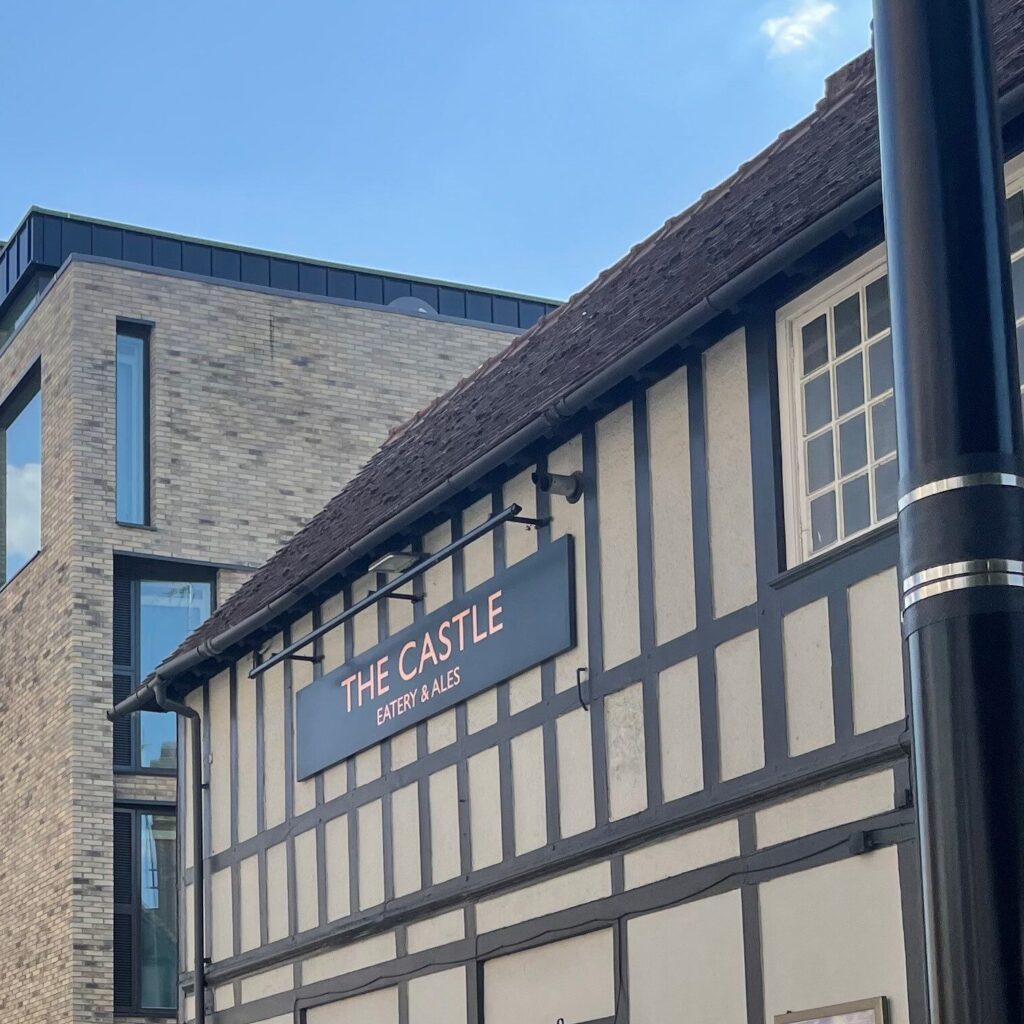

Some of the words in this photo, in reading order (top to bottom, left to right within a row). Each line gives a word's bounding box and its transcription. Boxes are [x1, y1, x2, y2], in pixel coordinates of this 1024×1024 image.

[341, 655, 390, 713] THE
[398, 590, 504, 681] CASTLE
[377, 689, 418, 726] EATERY
[421, 684, 429, 703] &
[431, 666, 461, 698] ALES
